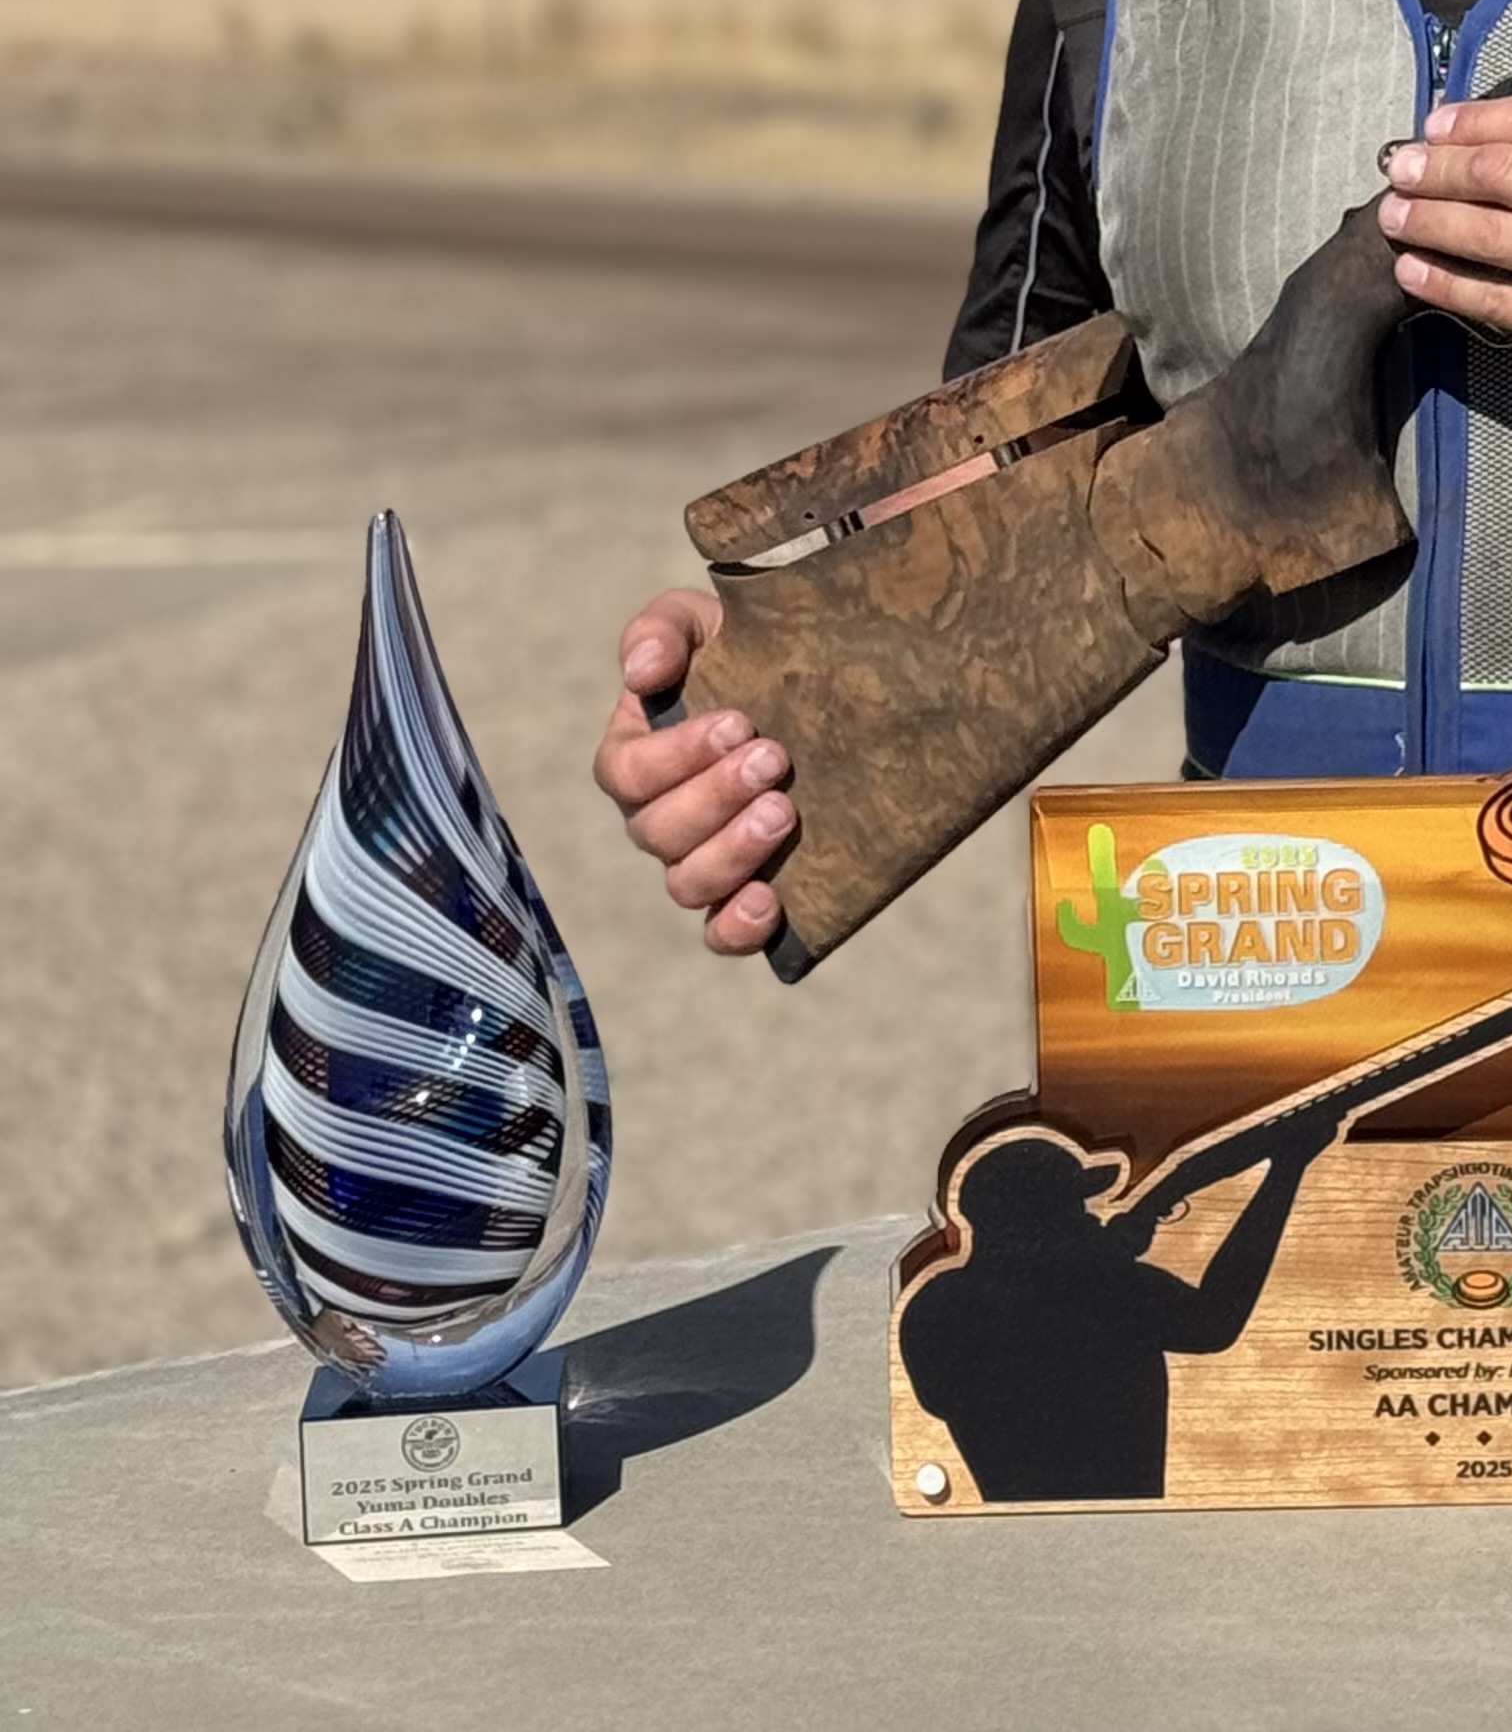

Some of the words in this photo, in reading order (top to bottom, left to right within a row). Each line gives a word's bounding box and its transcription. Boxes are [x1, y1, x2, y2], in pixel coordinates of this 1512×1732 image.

[1240, 844, 1319, 868] 2025
[1136, 868, 1364, 918] SPRING
[1142, 919, 1360, 968] GRAND
[1177, 970, 1239, 988] David
[1245, 969, 1327, 987] Rhoads
[1213, 989, 1292, 1003] President
[1395, 1214, 1426, 1292] AMATEUR
[1308, 1328, 1428, 1351] SINGLES
[1363, 1362, 1471, 1383] Sponsored
[1374, 1394, 1420, 1418] AA
[1456, 1460, 1512, 1478] 2025
[331, 1478, 386, 1497] 2025
[391, 1475, 463, 1495] Spring
[468, 1468, 533, 1487] Grand
[357, 1499, 416, 1515] Yuma
[422, 1491, 511, 1510] Doubles
[339, 1520, 394, 1537] Class
[399, 1518, 414, 1533] A
[420, 1512, 528, 1532] Champion
